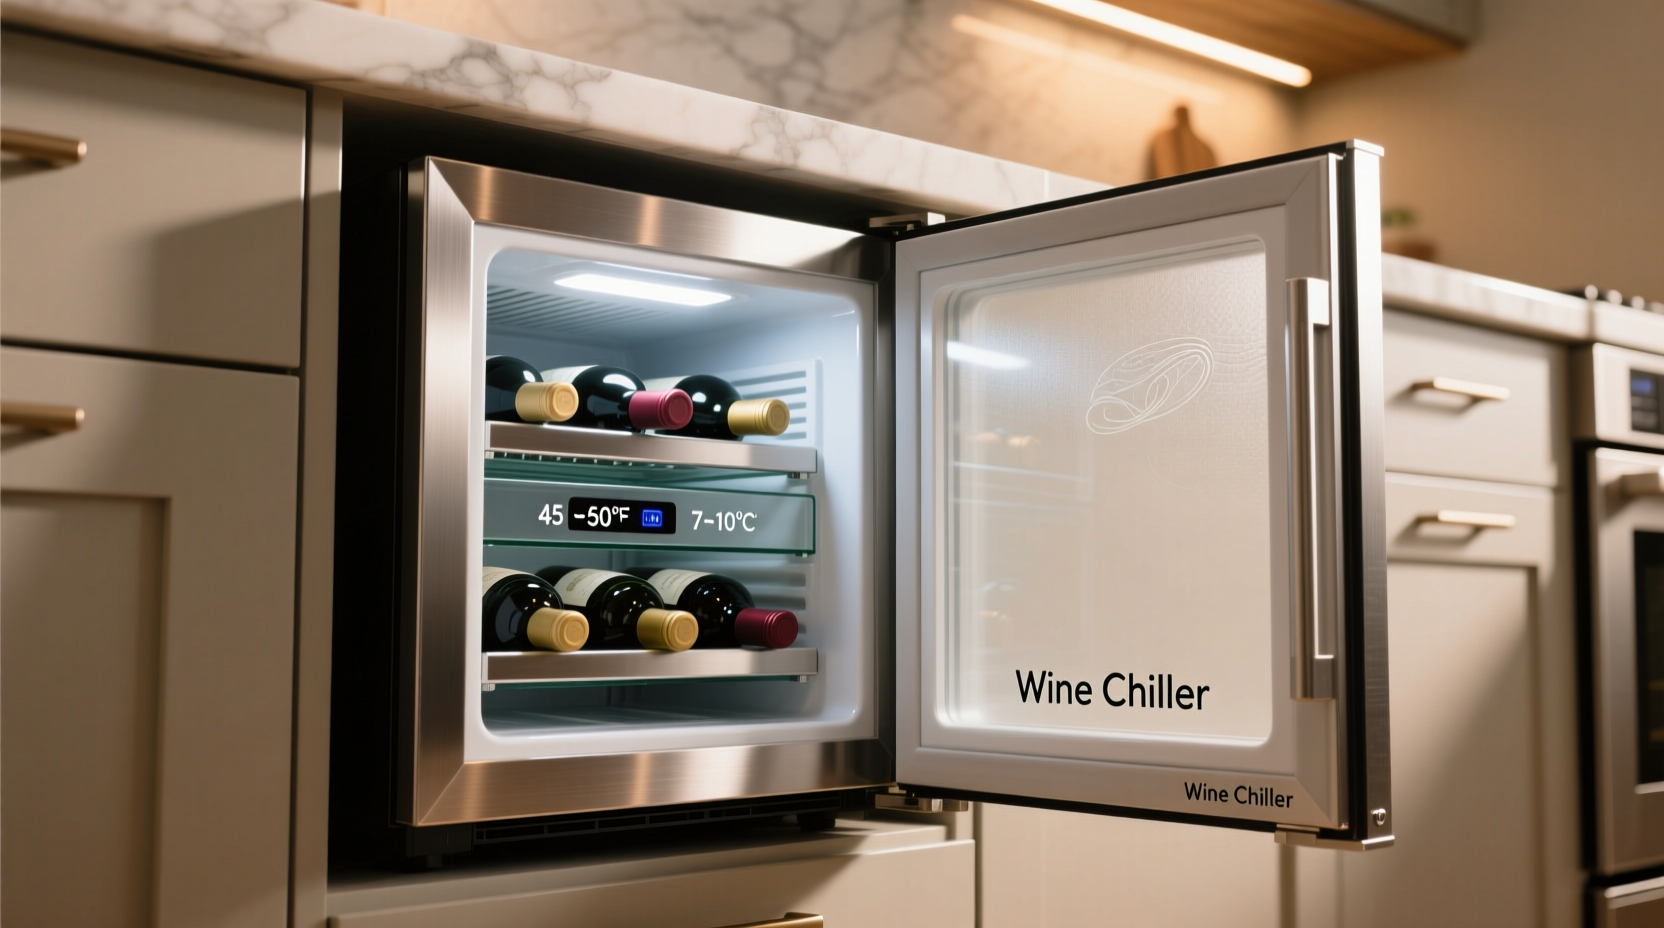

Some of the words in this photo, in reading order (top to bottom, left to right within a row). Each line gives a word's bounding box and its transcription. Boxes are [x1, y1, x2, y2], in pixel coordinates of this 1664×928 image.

[538, 503, 564, 526] 45
[1015, 669, 1093, 706] Wine
[1102, 672, 1211, 711] Chiller
[1183, 781, 1229, 803] Wine
[1233, 784, 1294, 809] Chiller
